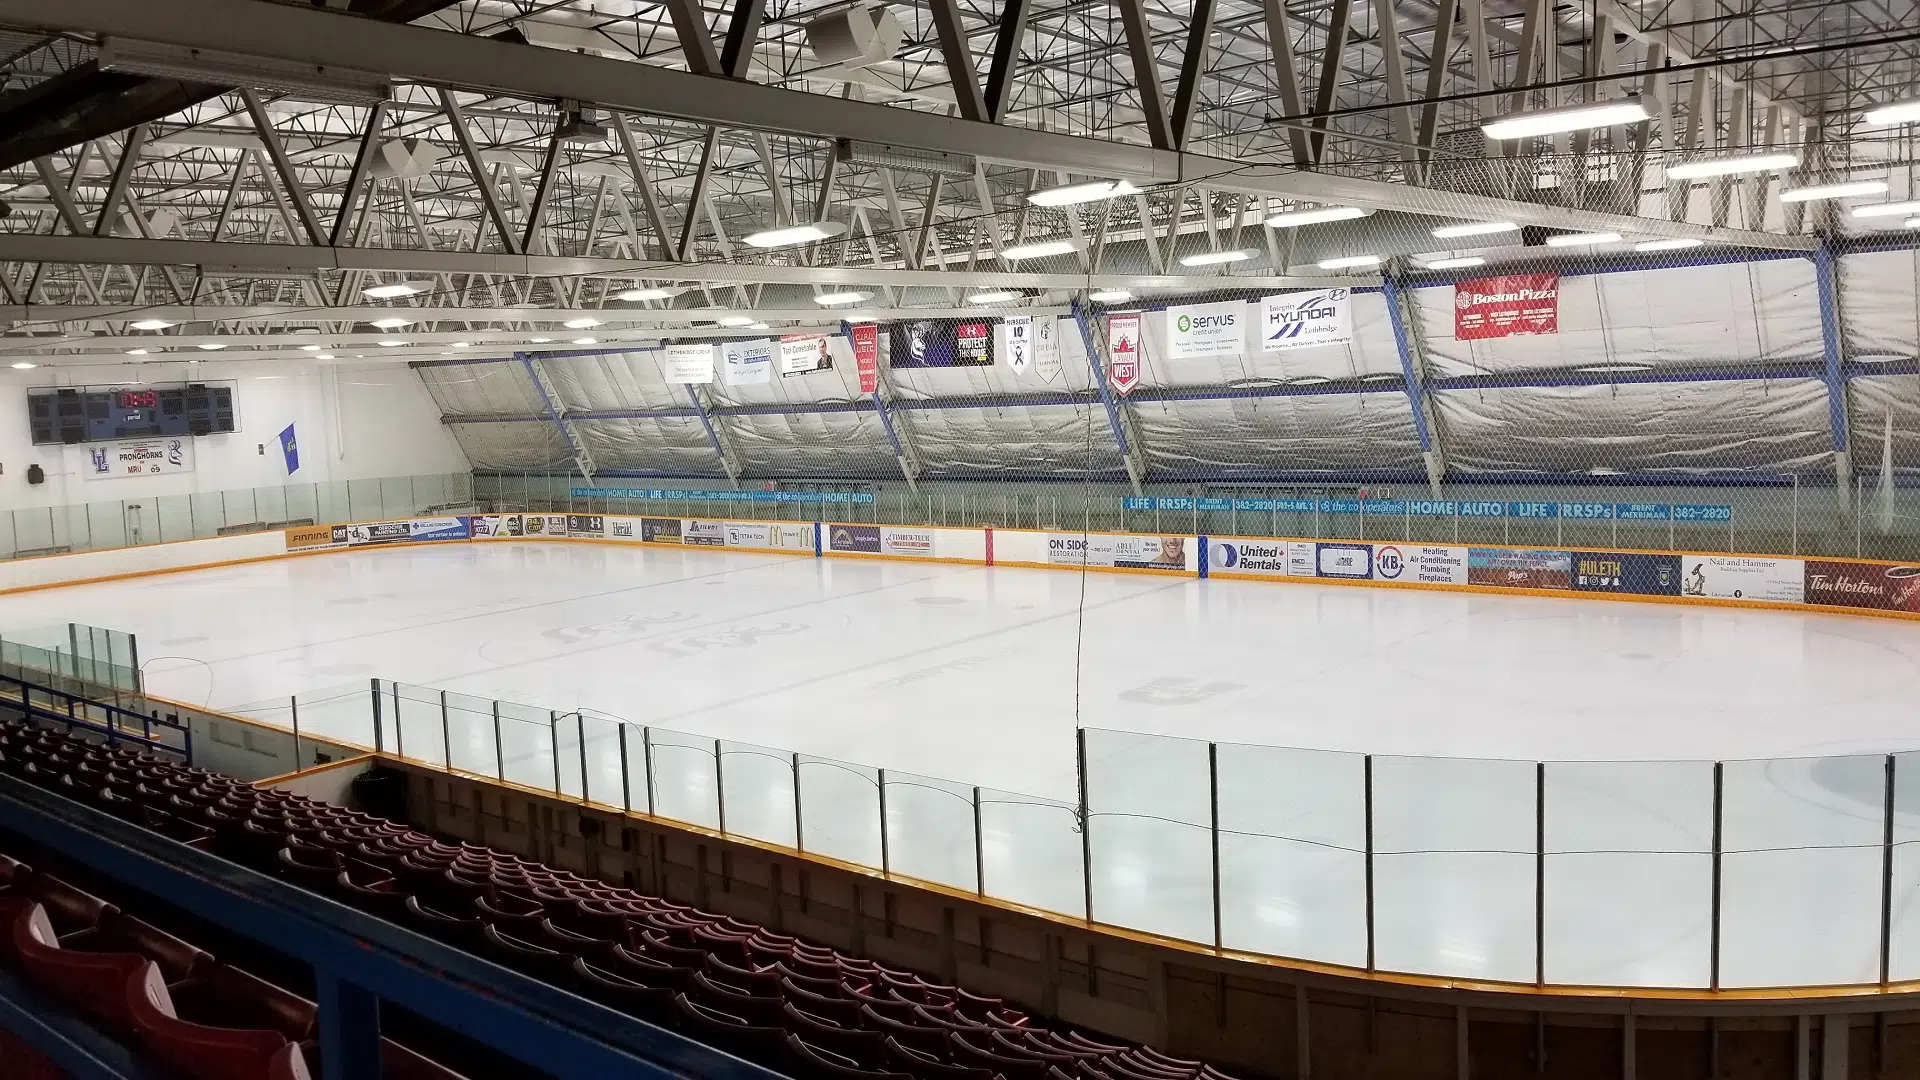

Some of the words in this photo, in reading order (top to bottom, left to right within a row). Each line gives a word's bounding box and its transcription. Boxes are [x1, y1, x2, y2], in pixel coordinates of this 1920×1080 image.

[1472, 293, 1518, 304] Boston
[1519, 289, 1556, 301] Pizza
[1269, 303, 1296, 312] Integrity
[1270, 307, 1336, 324] HYUNDAI
[1192, 315, 1235, 328] servus
[1013, 326, 1023, 337] 10
[1305, 325, 1338, 334] Lethbridge
[958, 338, 987, 348] PROTECT
[744, 347, 770, 358] EXTERIORS
[792, 343, 817, 354] Constable
[959, 349, 970, 357] THIS
[1114, 364, 1133, 377] WEST
[119, 451, 163, 460] PRONGHORNS
[128, 465, 141, 473] MRU
[650, 490, 662, 498] LIFE
[826, 493, 848, 502] HOME
[852, 494, 872, 502] AUTO
[1130, 498, 1149, 509] LIFE
[1160, 499, 1192, 510] RRSPs
[1235, 500, 1272, 510] 382-2820
[1333, 501, 1346, 510] the
[1348, 502, 1402, 514] cooperators
[1411, 502, 1453, 514] HOME
[1462, 503, 1501, 515] AUTO
[1520, 503, 1547, 516] LIFE
[1563, 504, 1611, 518] RRSPs
[1675, 507, 1730, 519] 382-2820
[612, 522, 632, 534] Herald
[293, 532, 329, 542] FINNING
[333, 529, 347, 538] CAT
[1049, 540, 1063, 549] ON
[1067, 540, 1088, 550] SIDE
[1240, 545, 1277, 558] United
[1423, 548, 1448, 556] Heating
[1240, 558, 1281, 571] Rentals
[1382, 555, 1398, 569] KB
[1420, 556, 1461, 566] Conditioning
[1709, 558, 1725, 566] Nail
[1727, 558, 1740, 566] and
[1742, 559, 1776, 568] Hammer
[1421, 565, 1450, 574] Plumbing
[1579, 561, 1620, 575] #ULETH
[1419, 574, 1451, 582] Fireplaces
[1507, 571, 1528, 580] Pop's
[1810, 575, 1832, 591] Tim
[1834, 576, 1883, 594] Hortons
